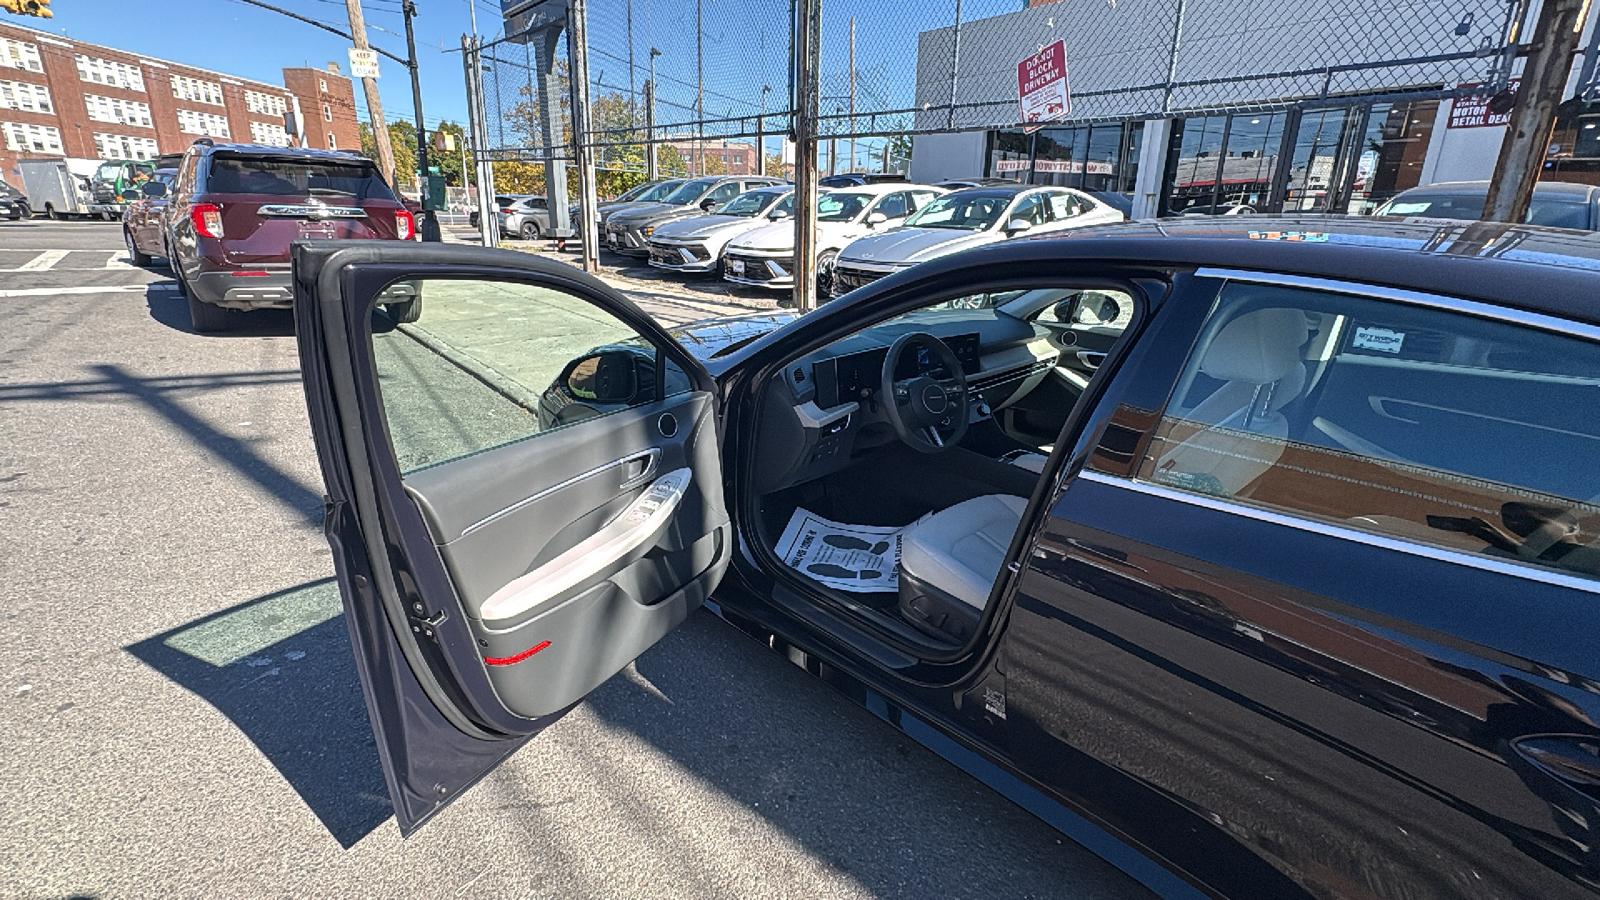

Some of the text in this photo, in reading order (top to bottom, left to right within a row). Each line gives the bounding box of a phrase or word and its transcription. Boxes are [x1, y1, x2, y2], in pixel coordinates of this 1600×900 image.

[1029, 60, 1053, 79] BLOCK
[1024, 68, 1060, 93] DRIVEWAY
[1452, 106, 1487, 117] MOTOR
[1452, 114, 1508, 127] RETAIL DEA
